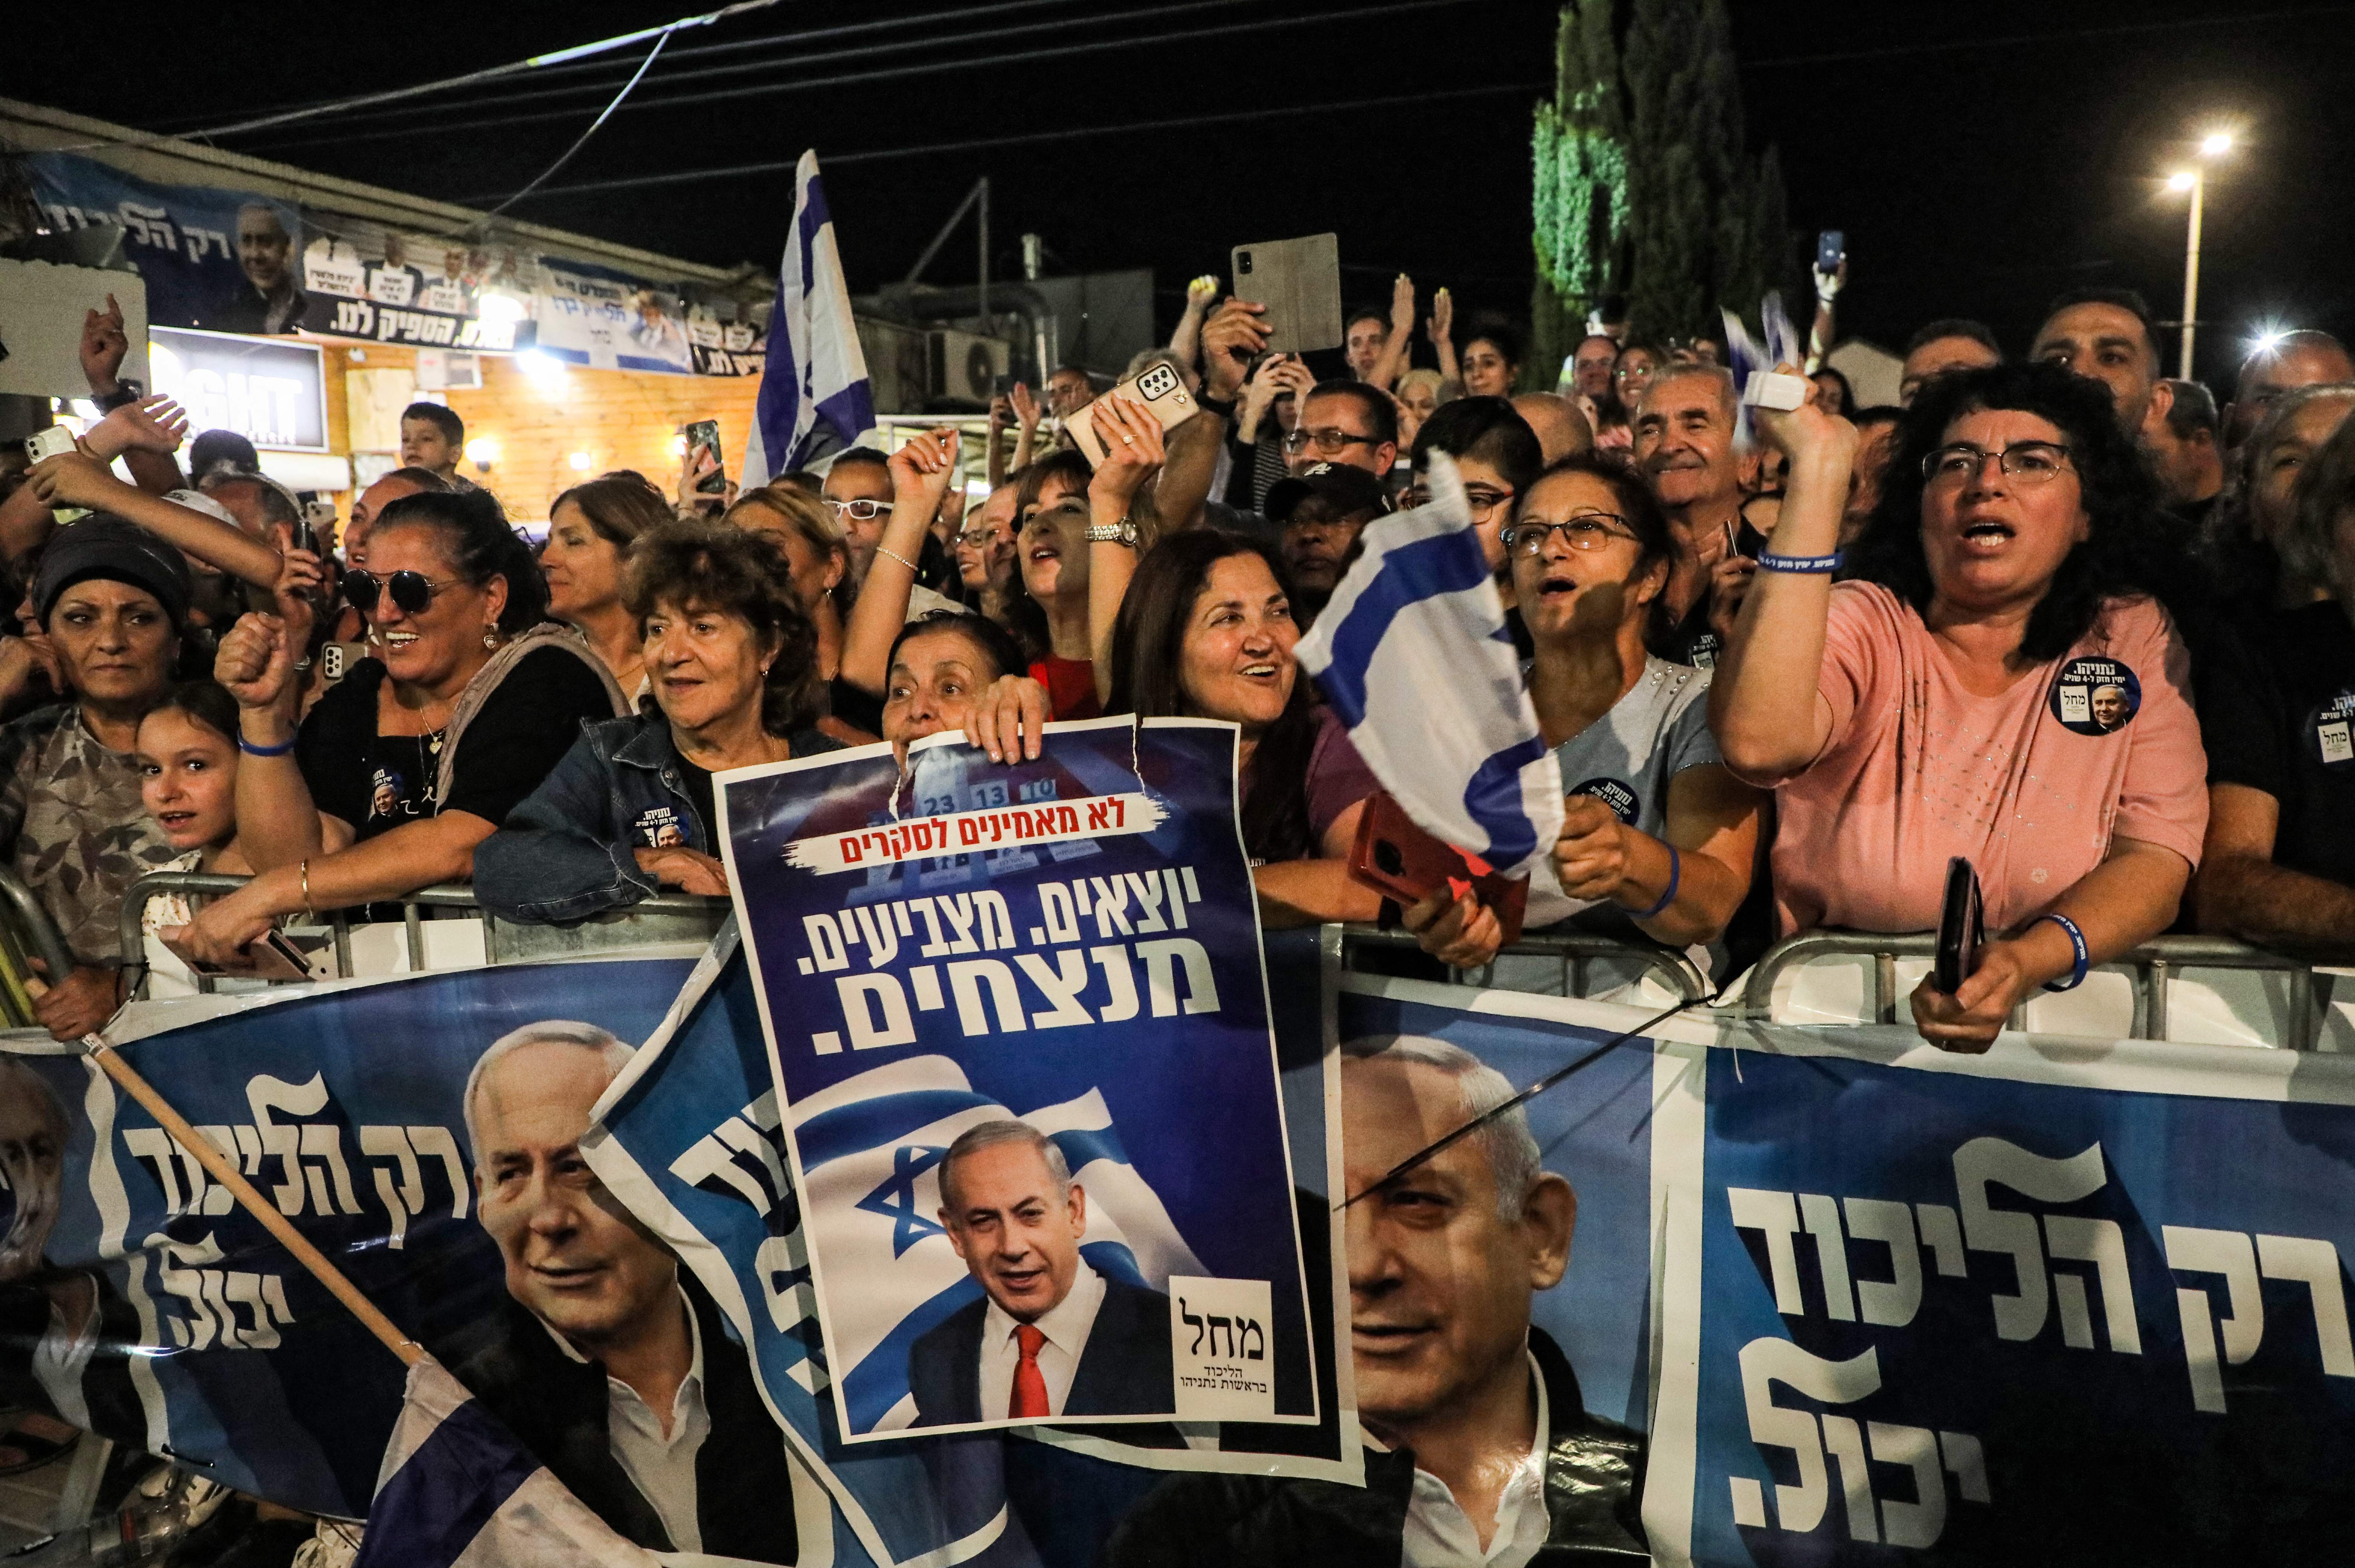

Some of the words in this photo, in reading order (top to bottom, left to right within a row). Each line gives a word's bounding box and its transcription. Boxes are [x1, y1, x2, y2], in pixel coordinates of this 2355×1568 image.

[181, 227, 231, 263] רק
[331, 300, 374, 334] לנו.
[378, 308, 456, 345] הספיק
[2073, 662, 2115, 675] נתניהו.
[2063, 691, 2085, 705] מחל
[2323, 731, 2347, 745] מחל
[924, 794, 956, 816] 23
[976, 786, 1006, 807] 13
[1027, 778, 1055, 799] 10
[1601, 781, 1633, 805] נתניהו.
[643, 807, 671, 821] נתניהו.
[958, 806, 1080, 847] מאמינים
[1087, 796, 1125, 831] לא
[840, 817, 947, 864] לסקרים
[1029, 866, 1201, 947] יוצאים.
[797, 889, 1017, 976] מצביעים.
[811, 938, 1222, 1056] מנצחים.
[123, 1070, 363, 1216] הליכוד
[360, 1125, 469, 1250] רק
[1727, 1136, 2143, 1355] הליכוד
[1178, 1296, 1264, 1361] מחל
[2161, 1225, 2355, 1414] רק
[1180, 1376, 1216, 1388] נתניהו
[1204, 1364, 1242, 1378] הליכוד
[1221, 1379, 1267, 1393] בראשות
[1728, 1336, 1992, 1549] יכול.
